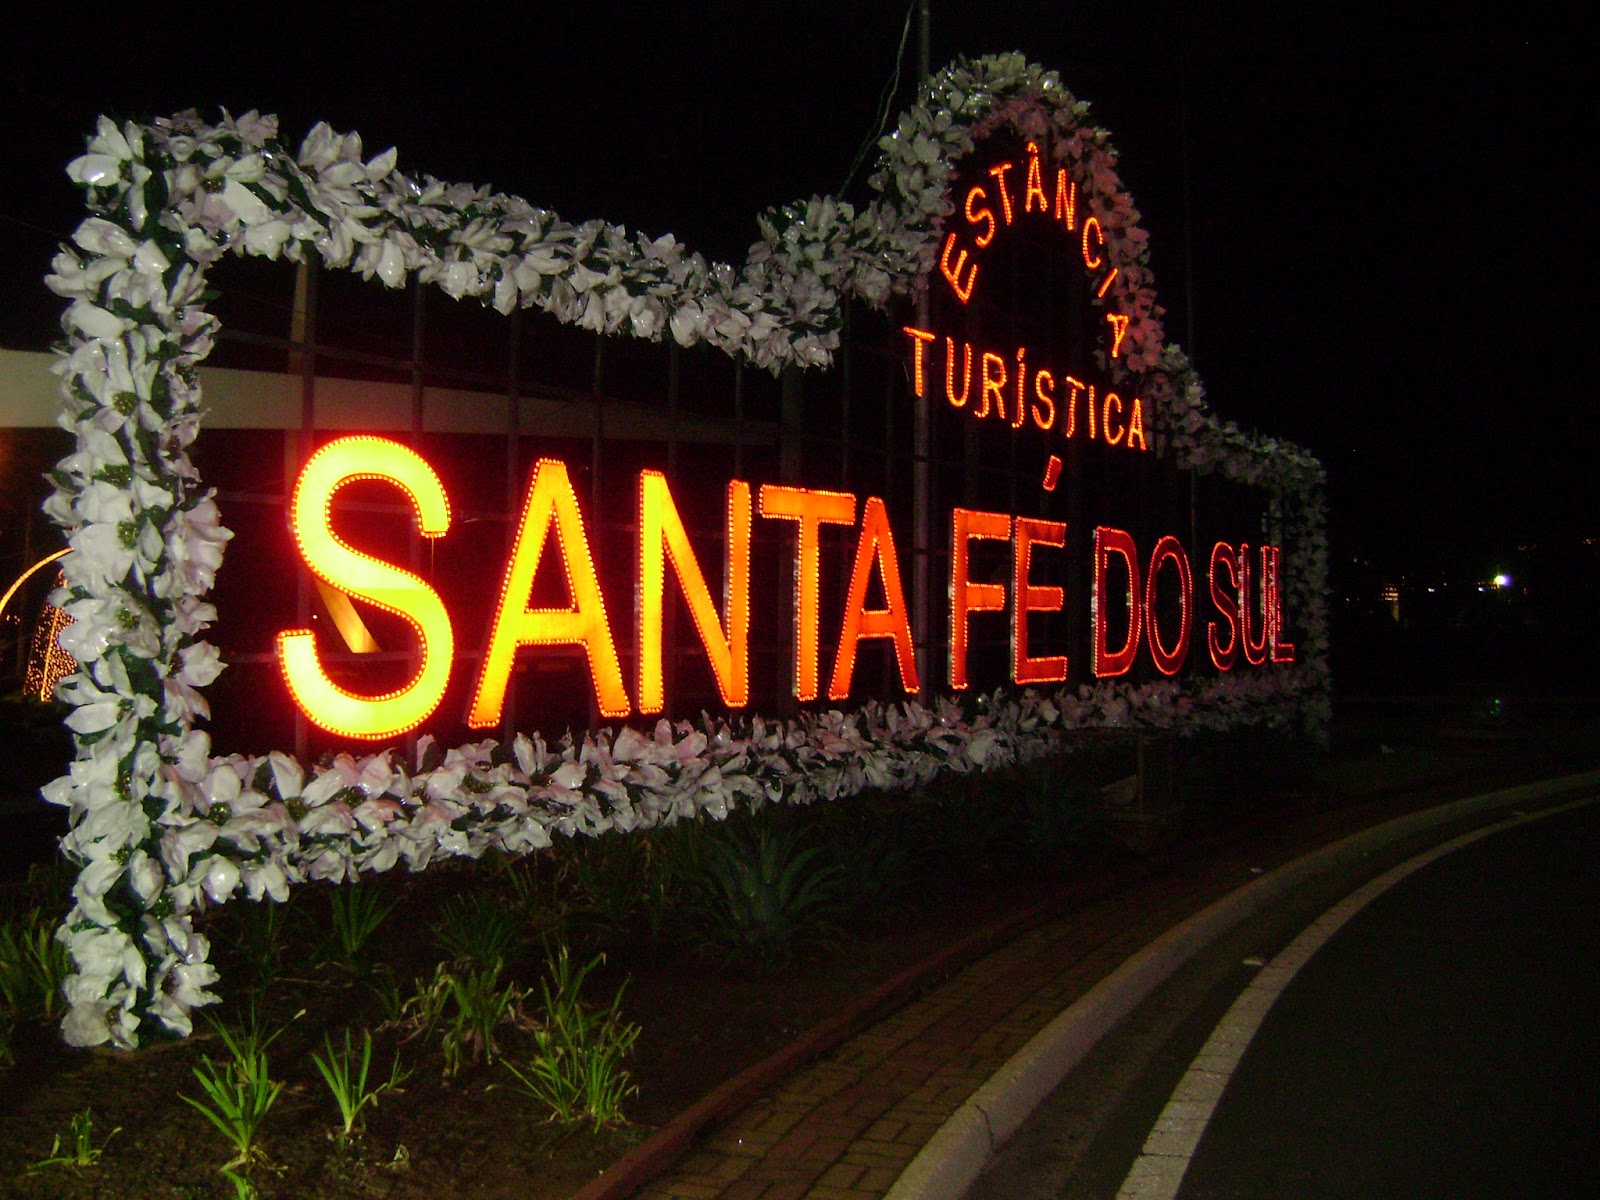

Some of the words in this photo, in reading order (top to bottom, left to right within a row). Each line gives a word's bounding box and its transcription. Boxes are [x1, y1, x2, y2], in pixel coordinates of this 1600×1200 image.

[939, 141, 1129, 358] ESTÂNCIA
[903, 326, 1147, 450] TURÍSTICA
[276, 435, 920, 741] SANTA
[950, 454, 1068, 690] FÉ
[1094, 525, 1193, 678] DO
[1207, 541, 1295, 671] SUL
